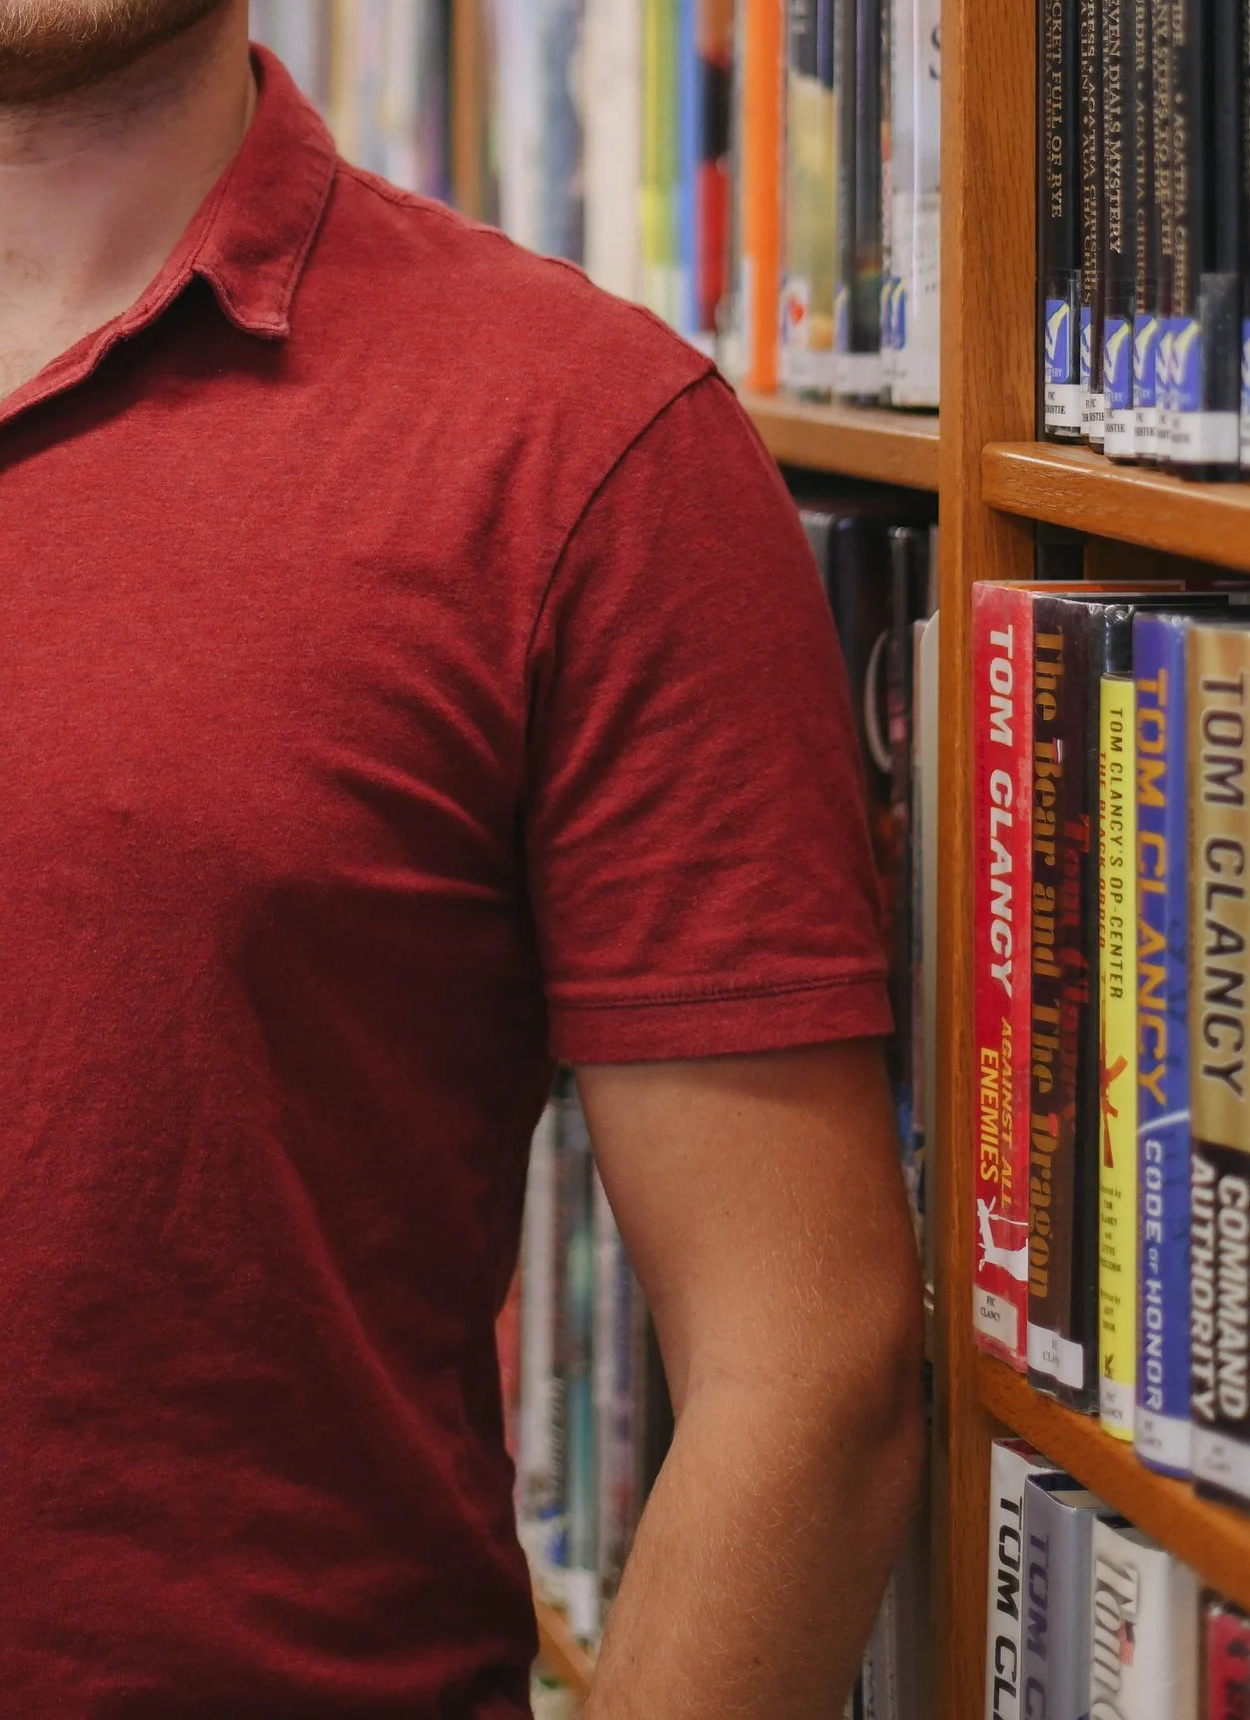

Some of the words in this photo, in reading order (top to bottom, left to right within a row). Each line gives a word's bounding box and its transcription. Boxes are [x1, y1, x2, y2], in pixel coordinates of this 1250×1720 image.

[1051, 71, 1063, 129] FULL
[1051, 135, 1063, 166] OF
[1108, 63, 1121, 133] DIALS
[1051, 173, 1063, 218] RYE
[1109, 140, 1122, 254] MYSTERY
[989, 623, 1014, 748] TOM
[1034, 623, 1065, 721] The
[1109, 707, 1124, 753] TOM
[1099, 750, 1107, 791] THE
[1136, 667, 1168, 809] TOM
[1201, 668, 1246, 808] TOM
[1033, 739, 1064, 867] Bear
[1109, 760, 1124, 868] CLANCY'S
[989, 768, 1014, 999] CLANCY
[1031, 880, 1062, 979] and
[1109, 876, 1124, 1000] OP-CENTER
[1136, 830, 1168, 1107] CLANCY
[1202, 835, 1246, 1098] CLANCY
[1000, 1015, 1014, 1150] AGAINST
[1031, 997, 1062, 1094] The
[979, 1046, 1000, 1184] ENEMIES
[1001, 1156, 1013, 1210] ALL
[1027, 1110, 1060, 1299] Dragon
[1145, 1139, 1164, 1245] CODE
[986, 1294, 996, 1308] FIC
[1147, 1246, 1160, 1275] OF
[1189, 1152, 1217, 1423] AUTHORITY
[1216, 1174, 1249, 1420] COMMAND
[1145, 1278, 1164, 1411] HONOR
[996, 1496, 1023, 1623] TOM
[1025, 1532, 1049, 1663] TOM
